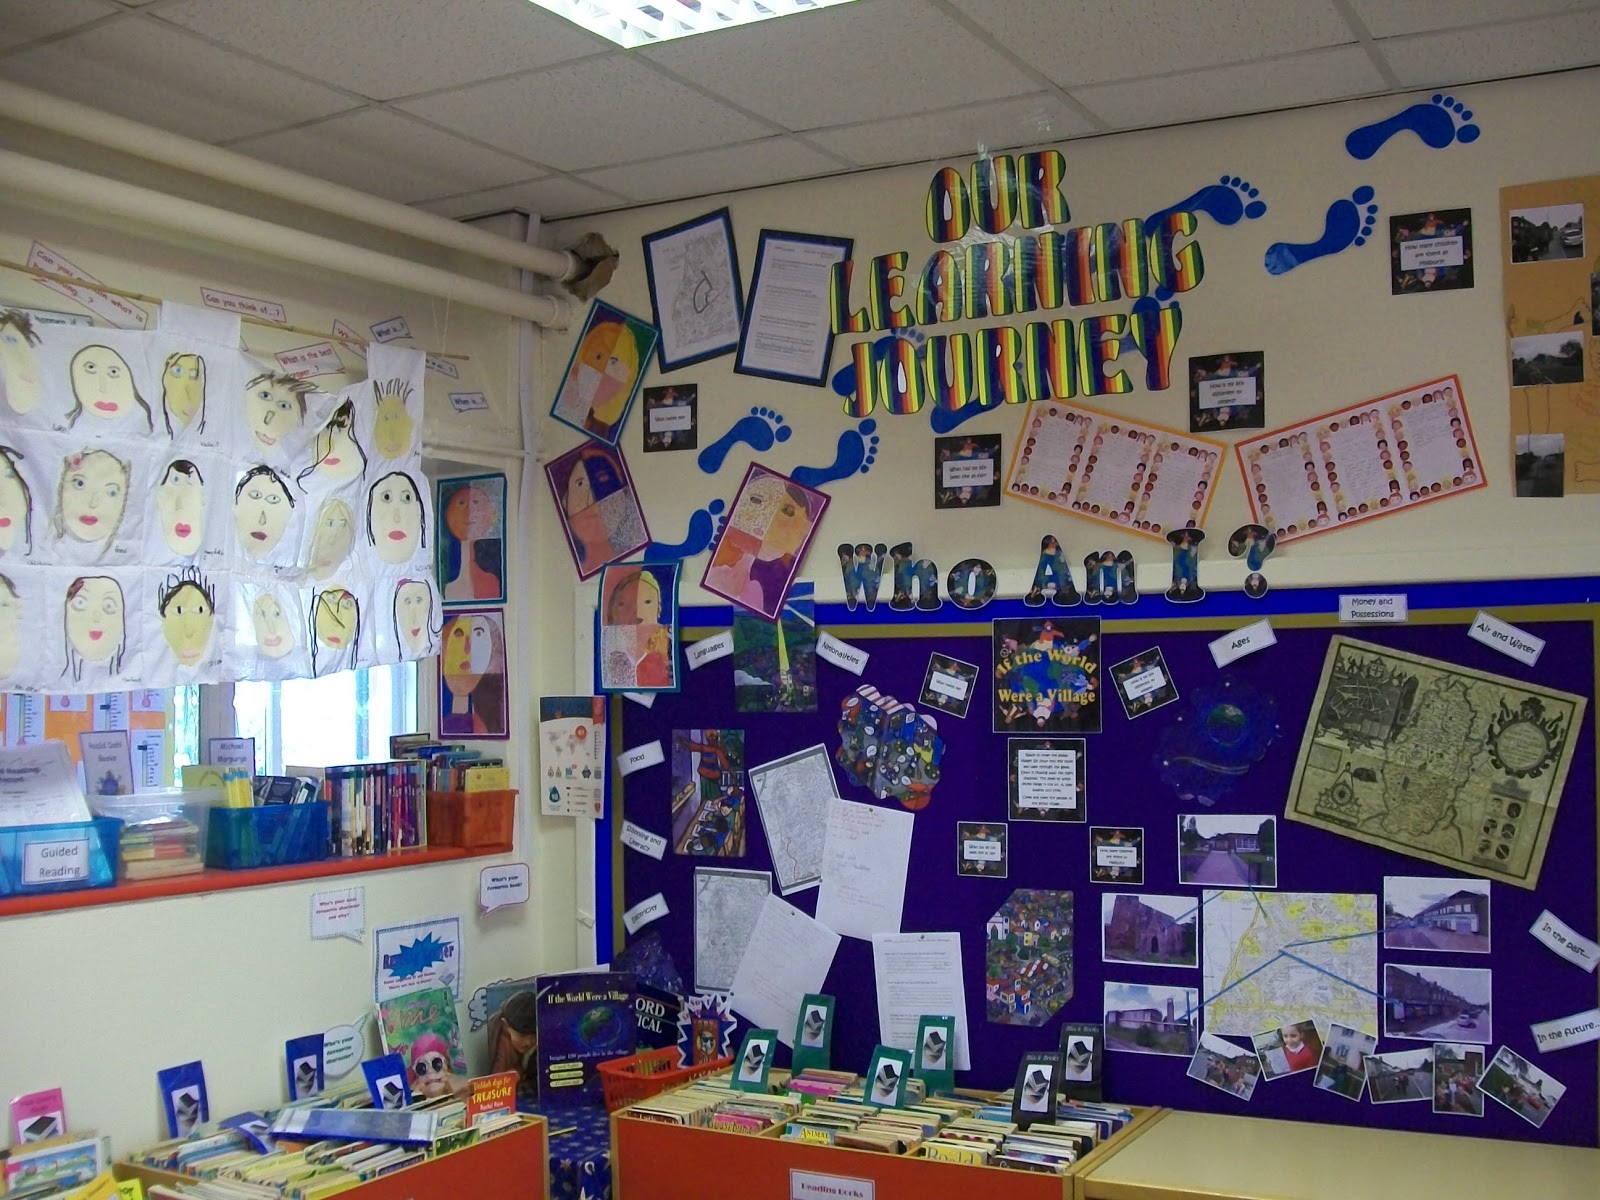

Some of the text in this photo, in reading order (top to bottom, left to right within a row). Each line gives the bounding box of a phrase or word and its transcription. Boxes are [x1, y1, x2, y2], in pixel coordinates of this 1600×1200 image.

[925, 149, 1071, 243] OUR
[36, 250, 54, 264] Can
[830, 211, 1204, 335] LEARNING
[206, 293, 220, 304] Can
[222, 299, 236, 308] you
[238, 302, 257, 311] think
[281, 356, 299, 366] What
[307, 351, 318, 359] the
[320, 348, 333, 356] best
[843, 306, 1183, 418] JOURNEY
[838, 523, 1276, 611] Who Am I ?
[1351, 597, 1393, 607] Money and
[1351, 609, 1395, 619] Possessions
[1231, 635, 1251, 650] Ages
[1476, 621, 1537, 656] Air and Water
[693, 641, 725, 660] Languages
[822, 641, 860, 665] Nationalities
[997, 649, 1097, 675] If the World
[998, 688, 1096, 706] Were a Village
[107, 740, 122, 749] Dahl
[220, 742, 243, 750] Michael
[97, 754, 116, 763] Books
[217, 755, 247, 764] Morpurgo
[630, 753, 645, 764] Food
[629, 837, 651, 852] Literacy
[649, 836, 662, 846] and
[41, 846, 78, 858] Guided
[39, 866, 81, 878] Reading
[631, 904, 657, 924] Electricity
[1542, 922, 1591, 960] In the past...
[548, 994, 555, 1004] If
[555, 993, 565, 1003] the
[565, 992, 585, 1002] World
[585, 991, 602, 1001] Were
[608, 990, 629, 1002] Village
[635, 1013, 662, 1034] ICAL
[1536, 1033, 1547, 1044] In
[1548, 1030, 1563, 1040] the
[471, 1087, 512, 1105] TREASURE
[800, 1127, 830, 1140] ANIMAL
